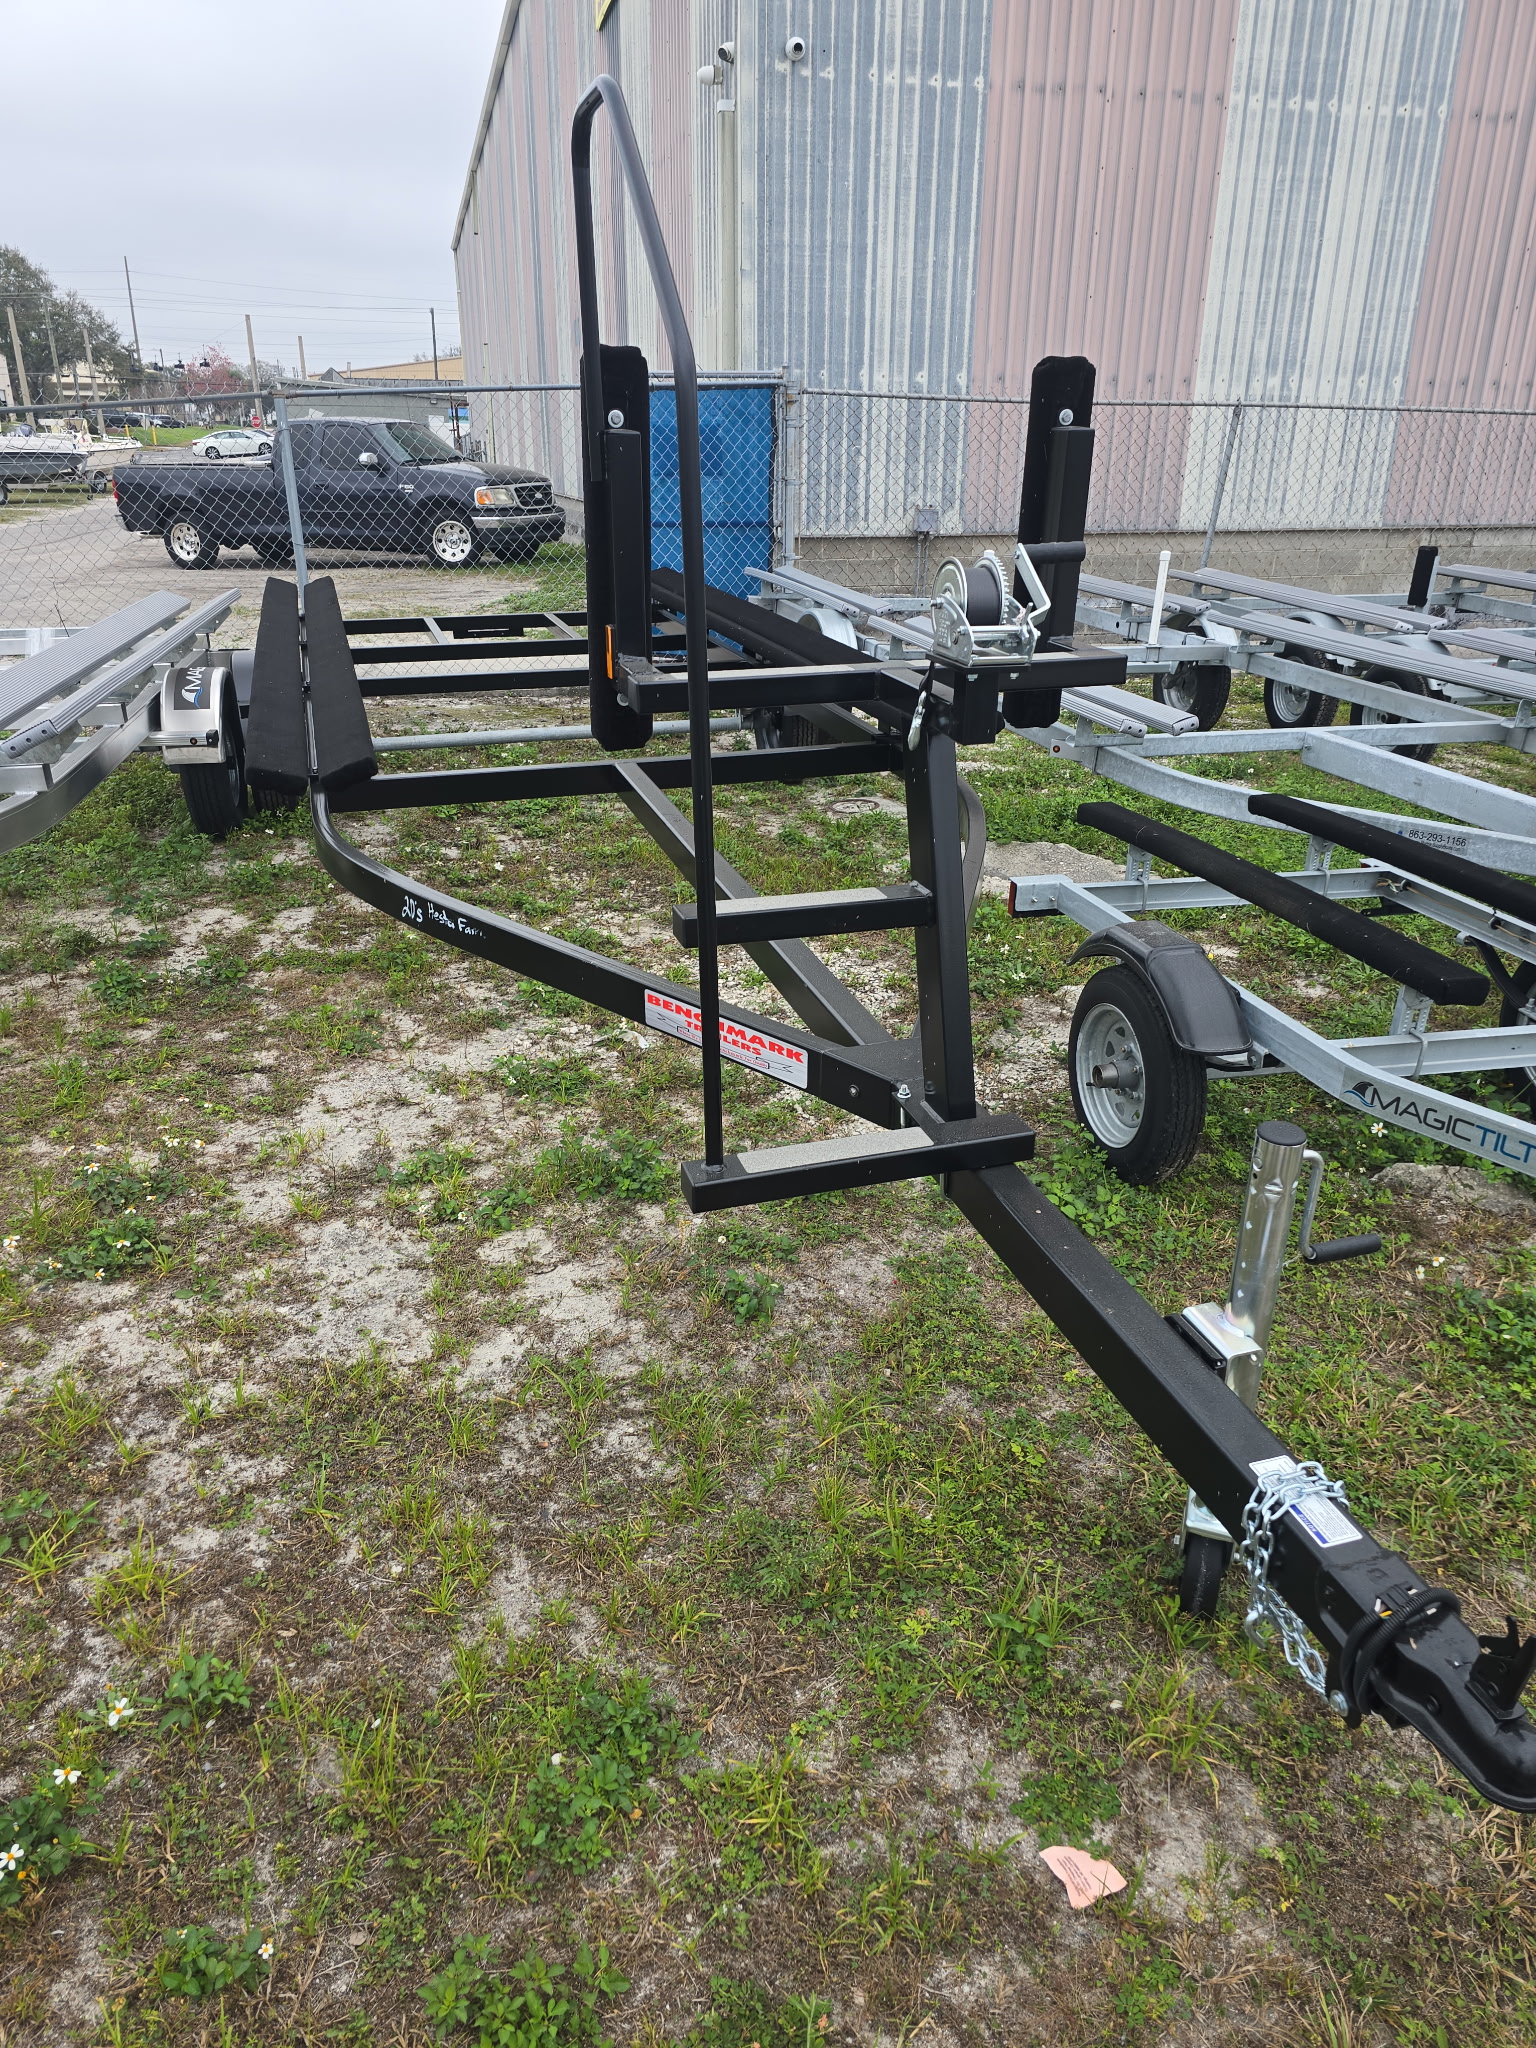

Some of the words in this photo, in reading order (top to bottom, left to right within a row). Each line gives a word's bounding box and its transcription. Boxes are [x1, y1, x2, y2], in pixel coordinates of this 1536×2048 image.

[1408, 829, 1467, 847] 863-293-1156
[685, 1019, 762, 1056] TRILERS
[1370, 1087, 1536, 1164] MAGICTILT
